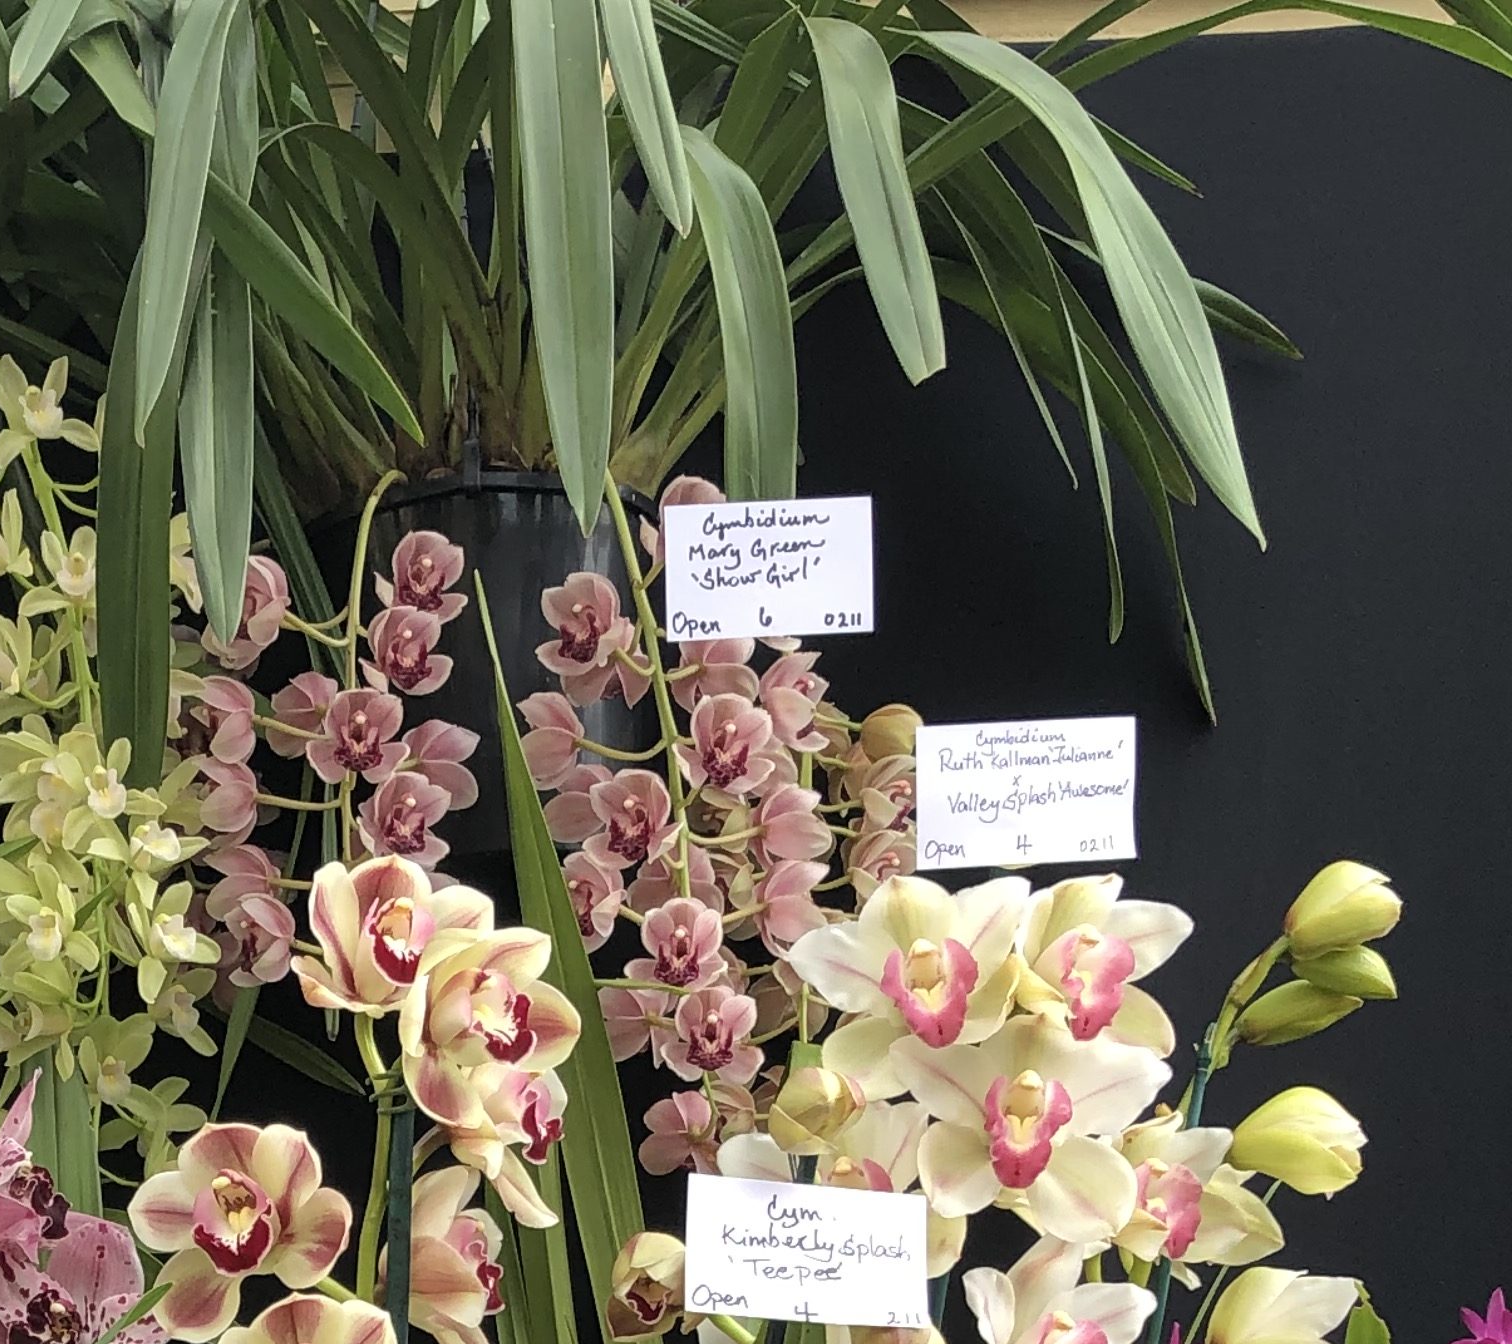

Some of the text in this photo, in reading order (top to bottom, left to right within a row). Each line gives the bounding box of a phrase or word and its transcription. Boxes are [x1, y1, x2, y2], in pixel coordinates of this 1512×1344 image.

[703, 507, 830, 541] Cymbidium
[689, 538, 825, 569] Mary Green
[673, 607, 861, 637] Open 6 0211
[976, 727, 1066, 756] Cymbidium
[938, 748, 983, 772] Ruth
[948, 792, 1000, 823] Valley
[1002, 782, 1056, 814] Splash
[924, 834, 1114, 865] Open 4 0211
[722, 1223, 834, 1263] Kimberly
[692, 1284, 748, 1311] Open
[794, 1301, 819, 1322] 4
